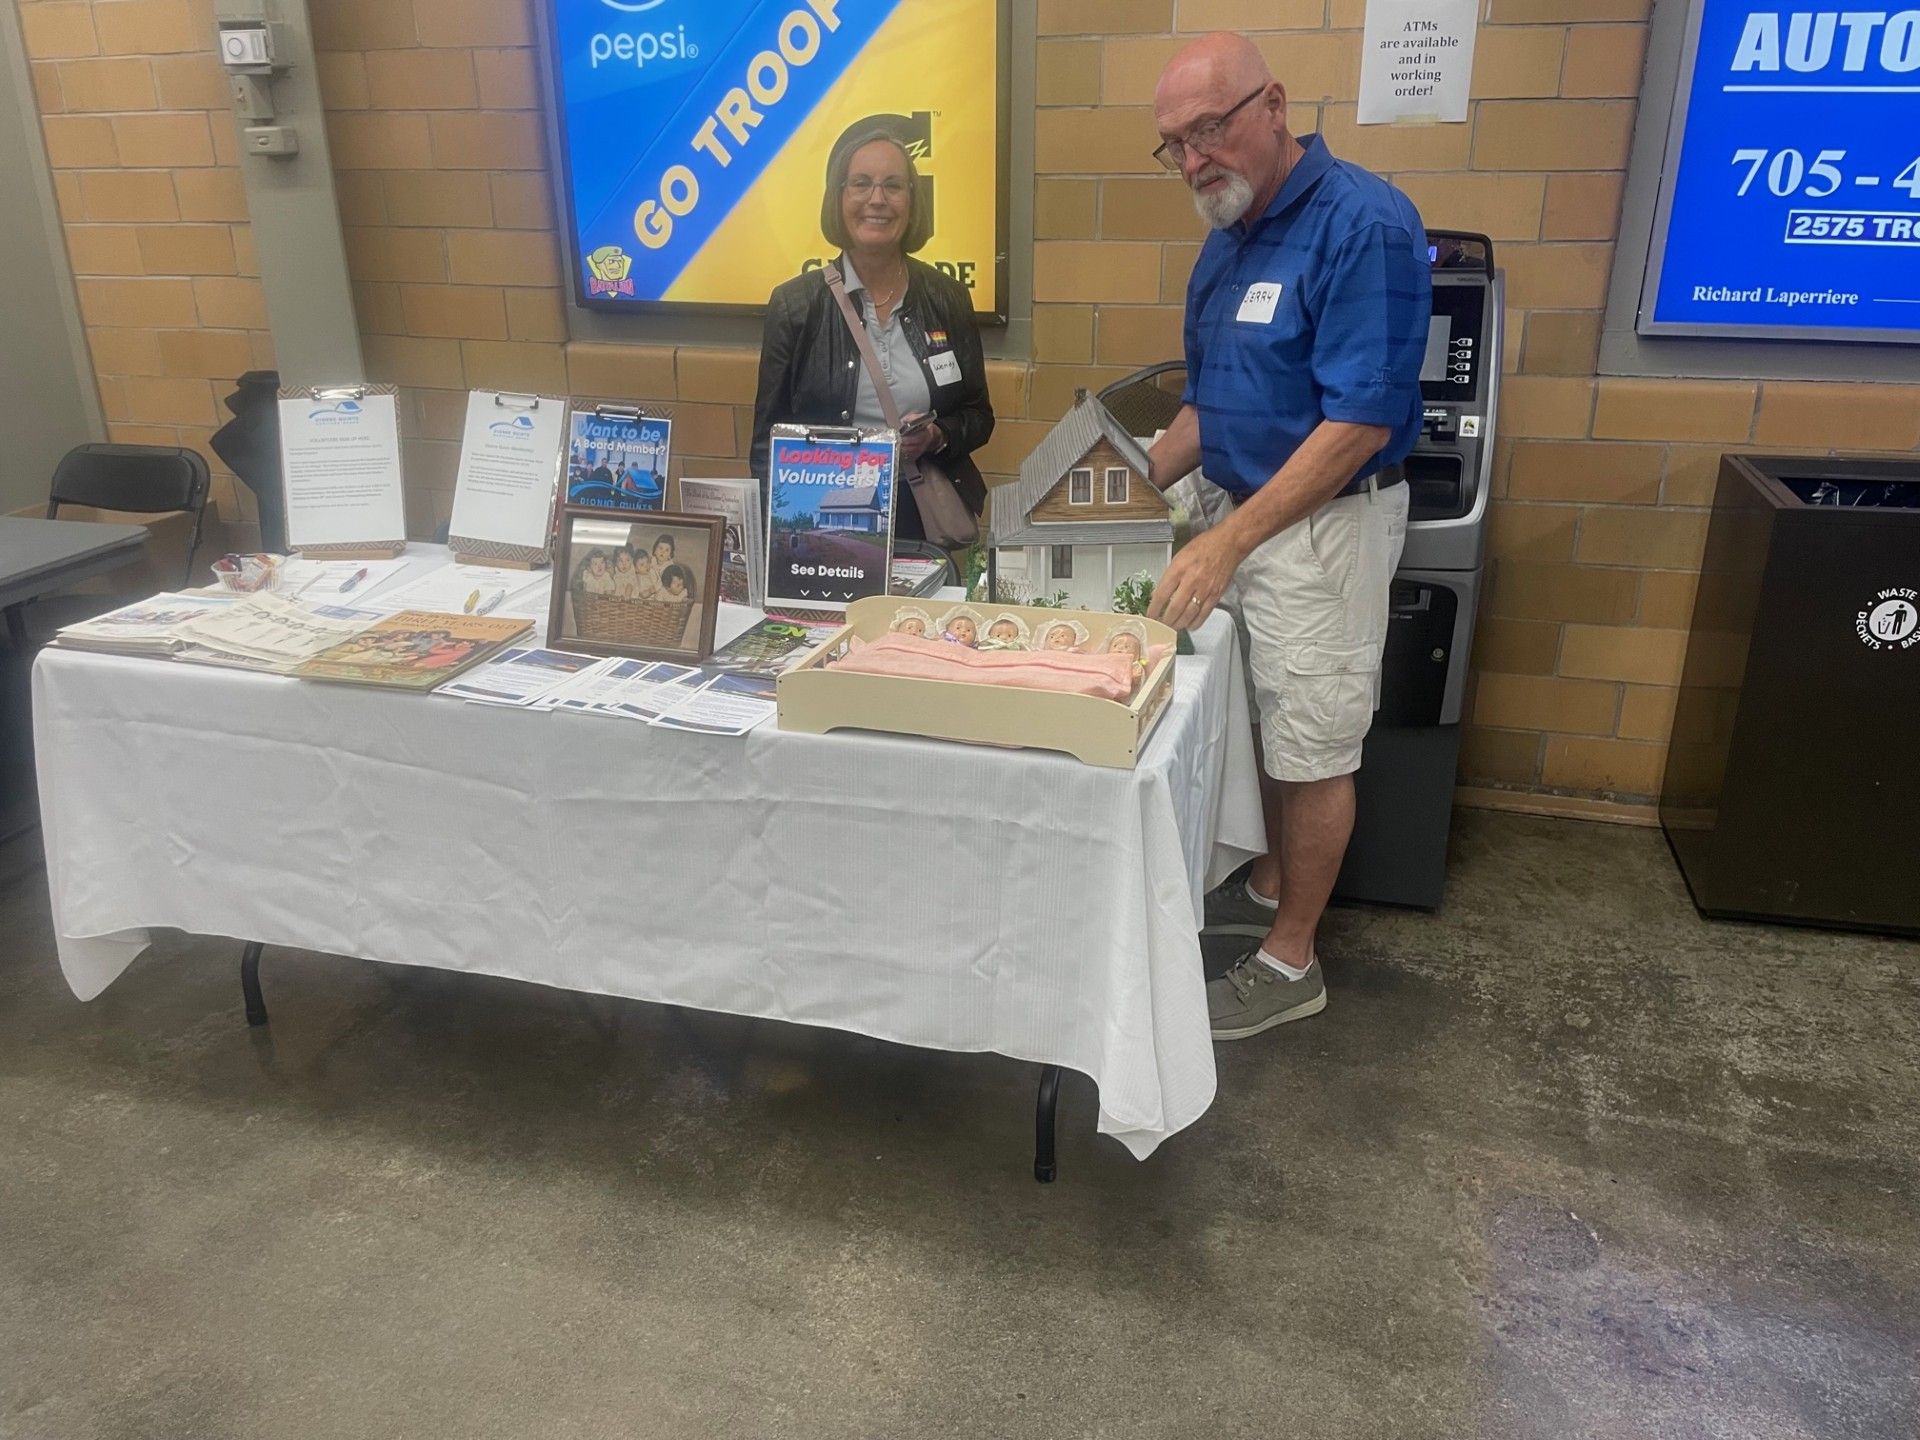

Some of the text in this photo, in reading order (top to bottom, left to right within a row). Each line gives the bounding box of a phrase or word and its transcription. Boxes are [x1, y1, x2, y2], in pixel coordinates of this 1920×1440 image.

[1403, 21, 1438, 32] ATMs
[1380, 37, 1459, 49] are available
[1399, 53, 1436, 64] and in
[1391, 69, 1441, 82] working
[1395, 85, 1433, 97] order!
[634, 165, 699, 249] GO
[1793, 216, 1865, 237] 2575
[1692, 286, 1859, 307] Richard Laperriere
[576, 420, 660, 442] Want to be
[574, 439, 666, 455] A Board Member?
[779, 448, 888, 468] Looking For
[778, 468, 881, 488] Volunteers!
[791, 563, 864, 579] See Details
[1877, 588, 1918, 600] WASTE
[1901, 626, 1920, 649] BAS
